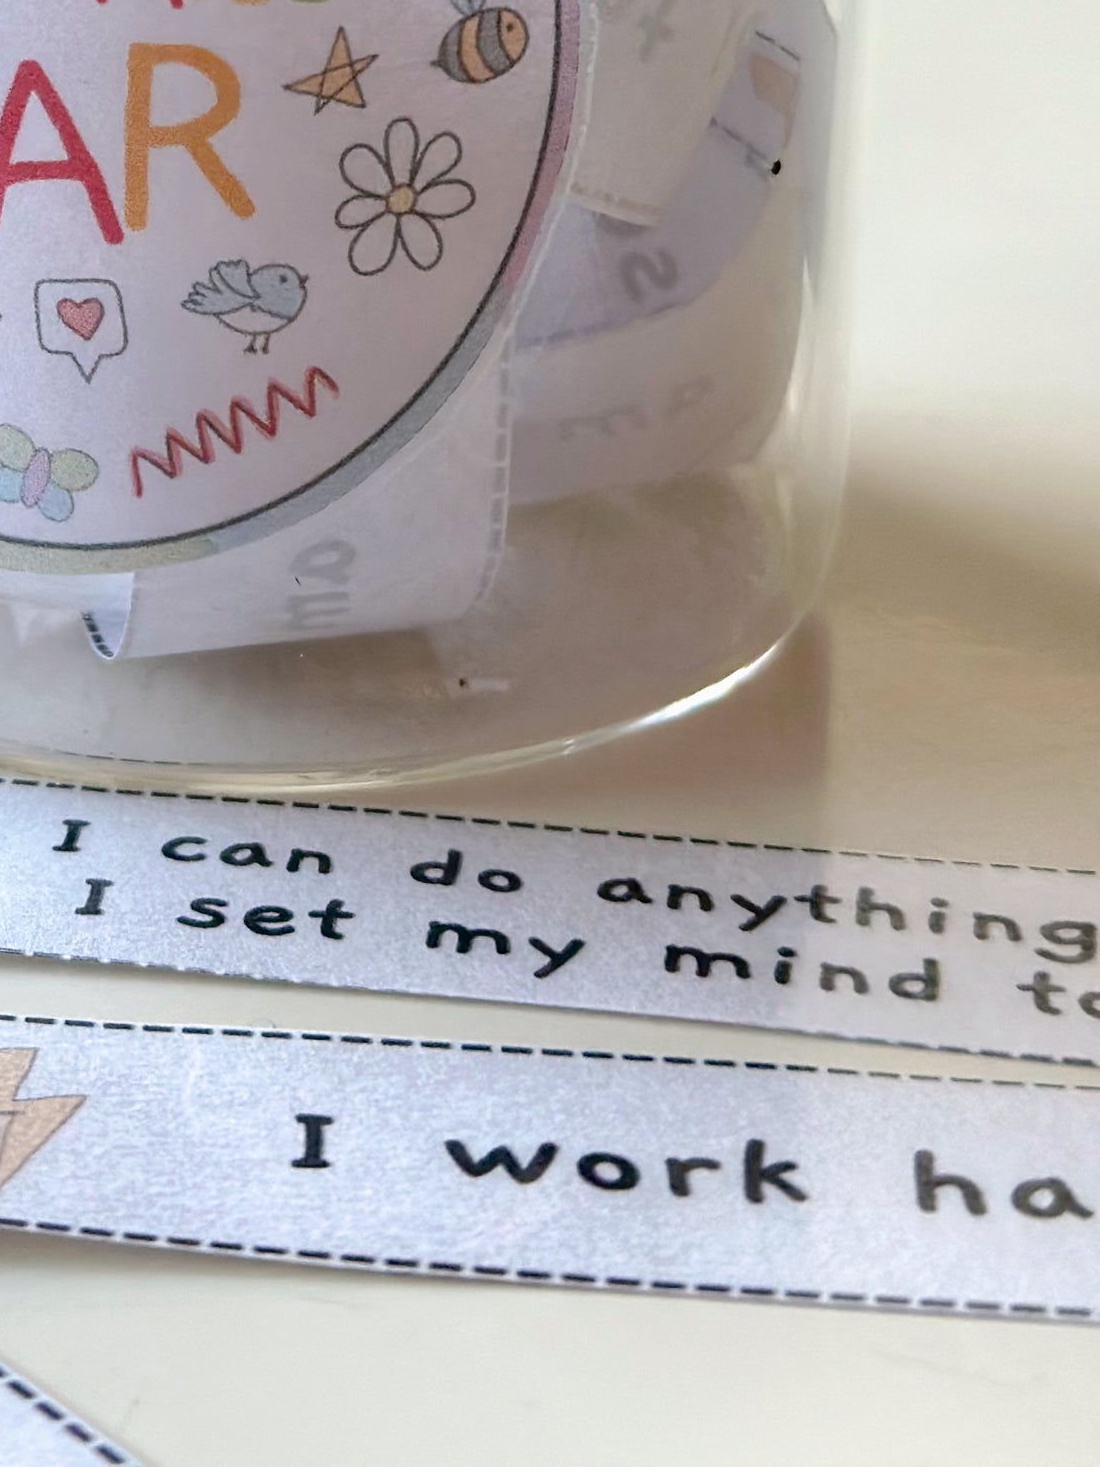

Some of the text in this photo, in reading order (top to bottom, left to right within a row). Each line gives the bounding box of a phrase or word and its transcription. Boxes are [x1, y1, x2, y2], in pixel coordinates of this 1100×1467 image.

[52, 819, 1098, 965] I can do anything
[74, 878, 114, 916] I
[175, 896, 357, 941] set
[424, 920, 587, 980] my
[663, 943, 941, 1002] mind
[290, 1112, 1097, 1221] I work ha
